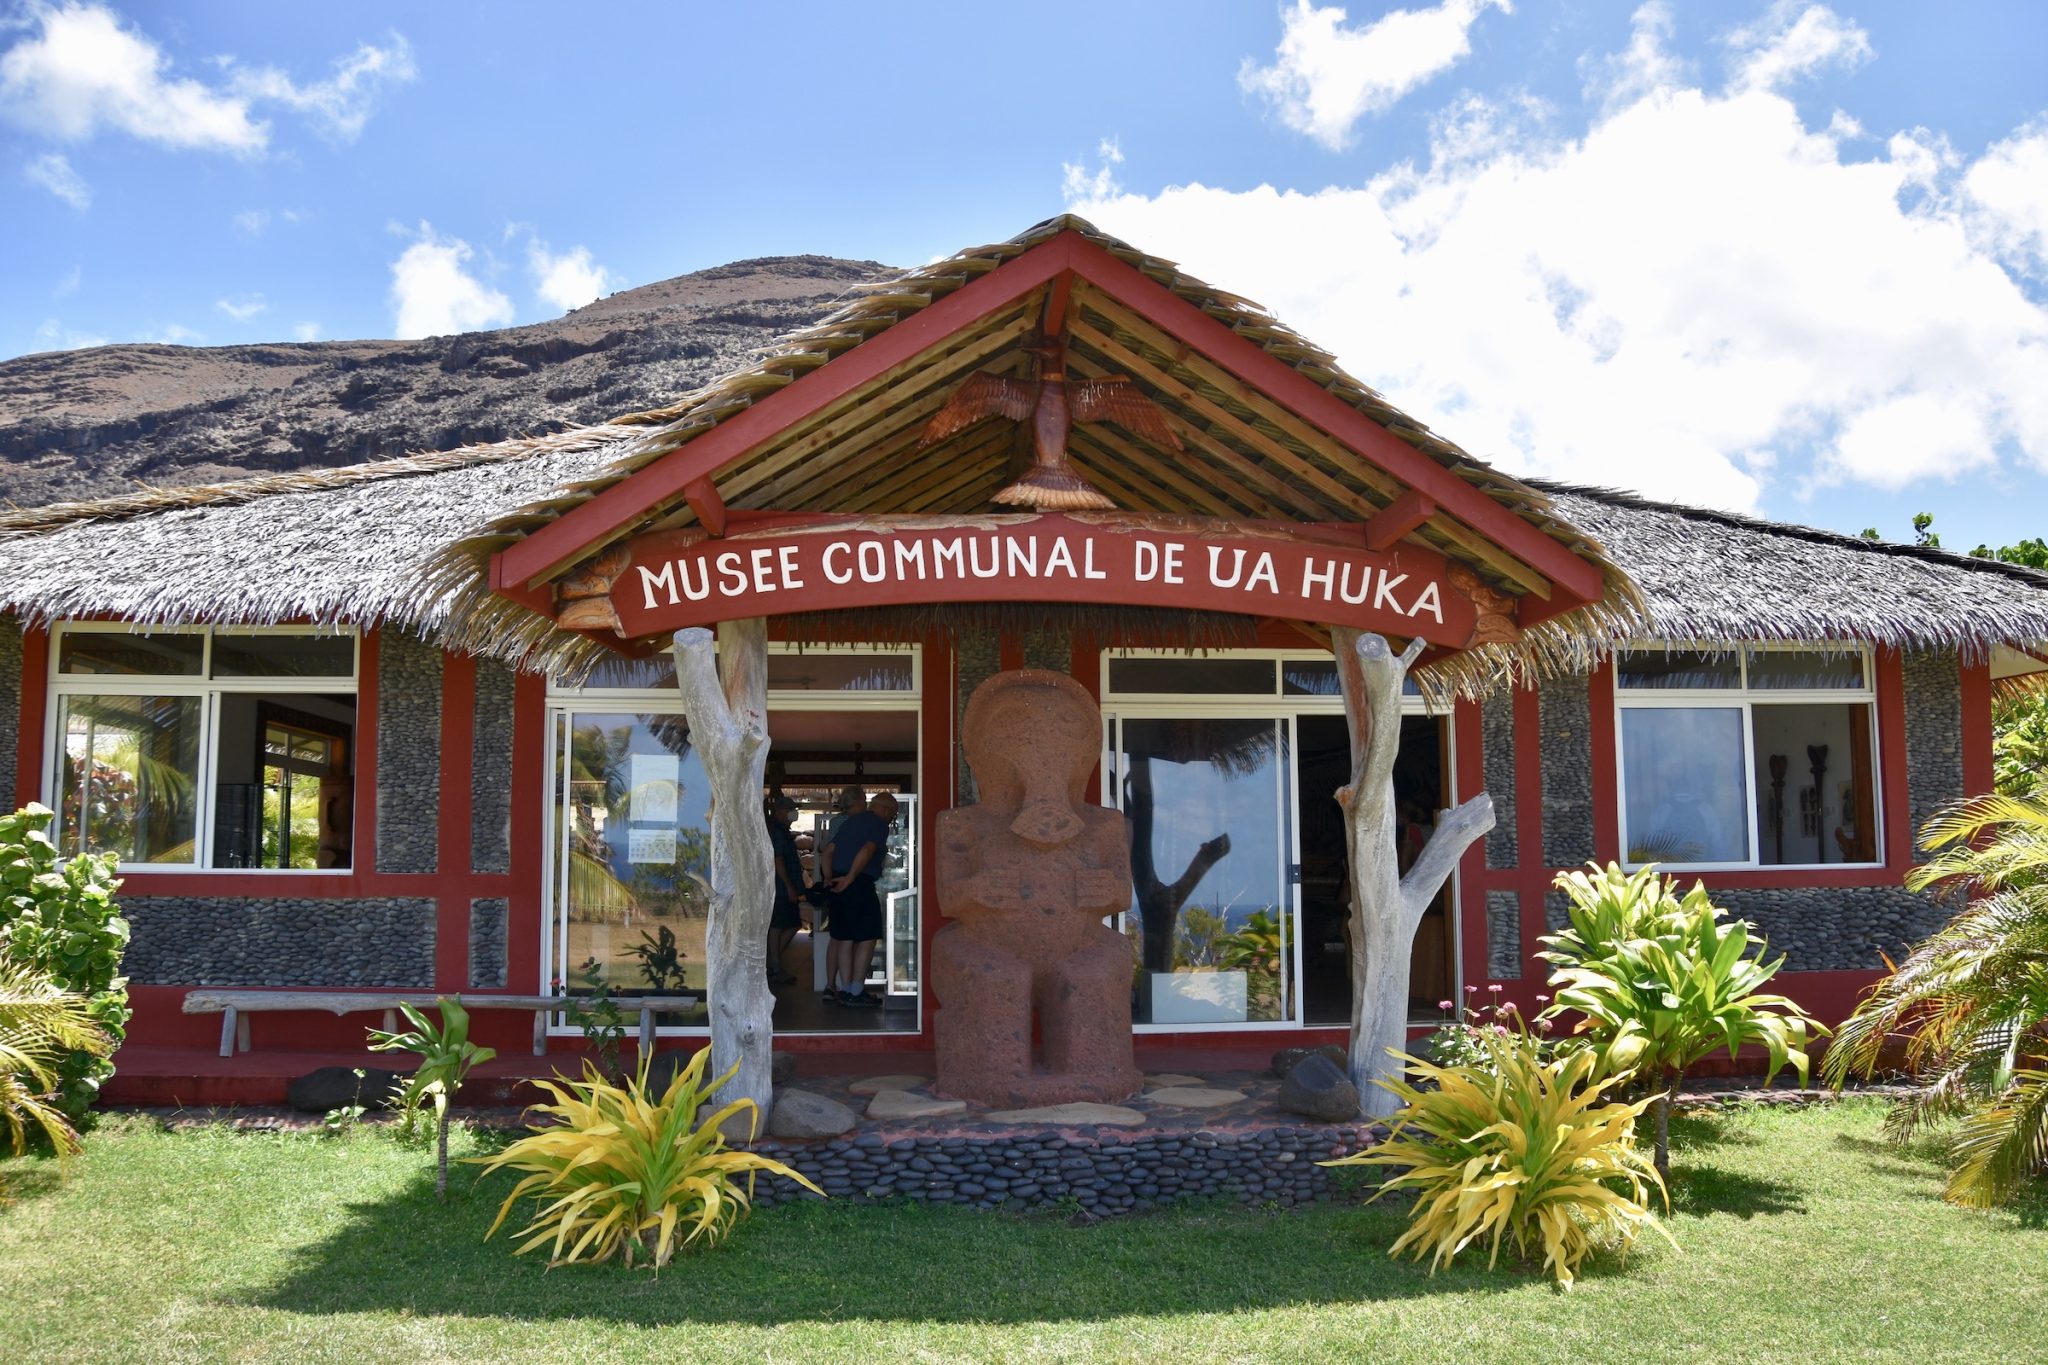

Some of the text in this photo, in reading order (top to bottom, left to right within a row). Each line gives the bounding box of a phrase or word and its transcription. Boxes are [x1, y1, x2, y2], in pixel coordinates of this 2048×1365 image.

[637, 535, 1444, 624] MUSEE COMMUNAL DE UA HUKA
